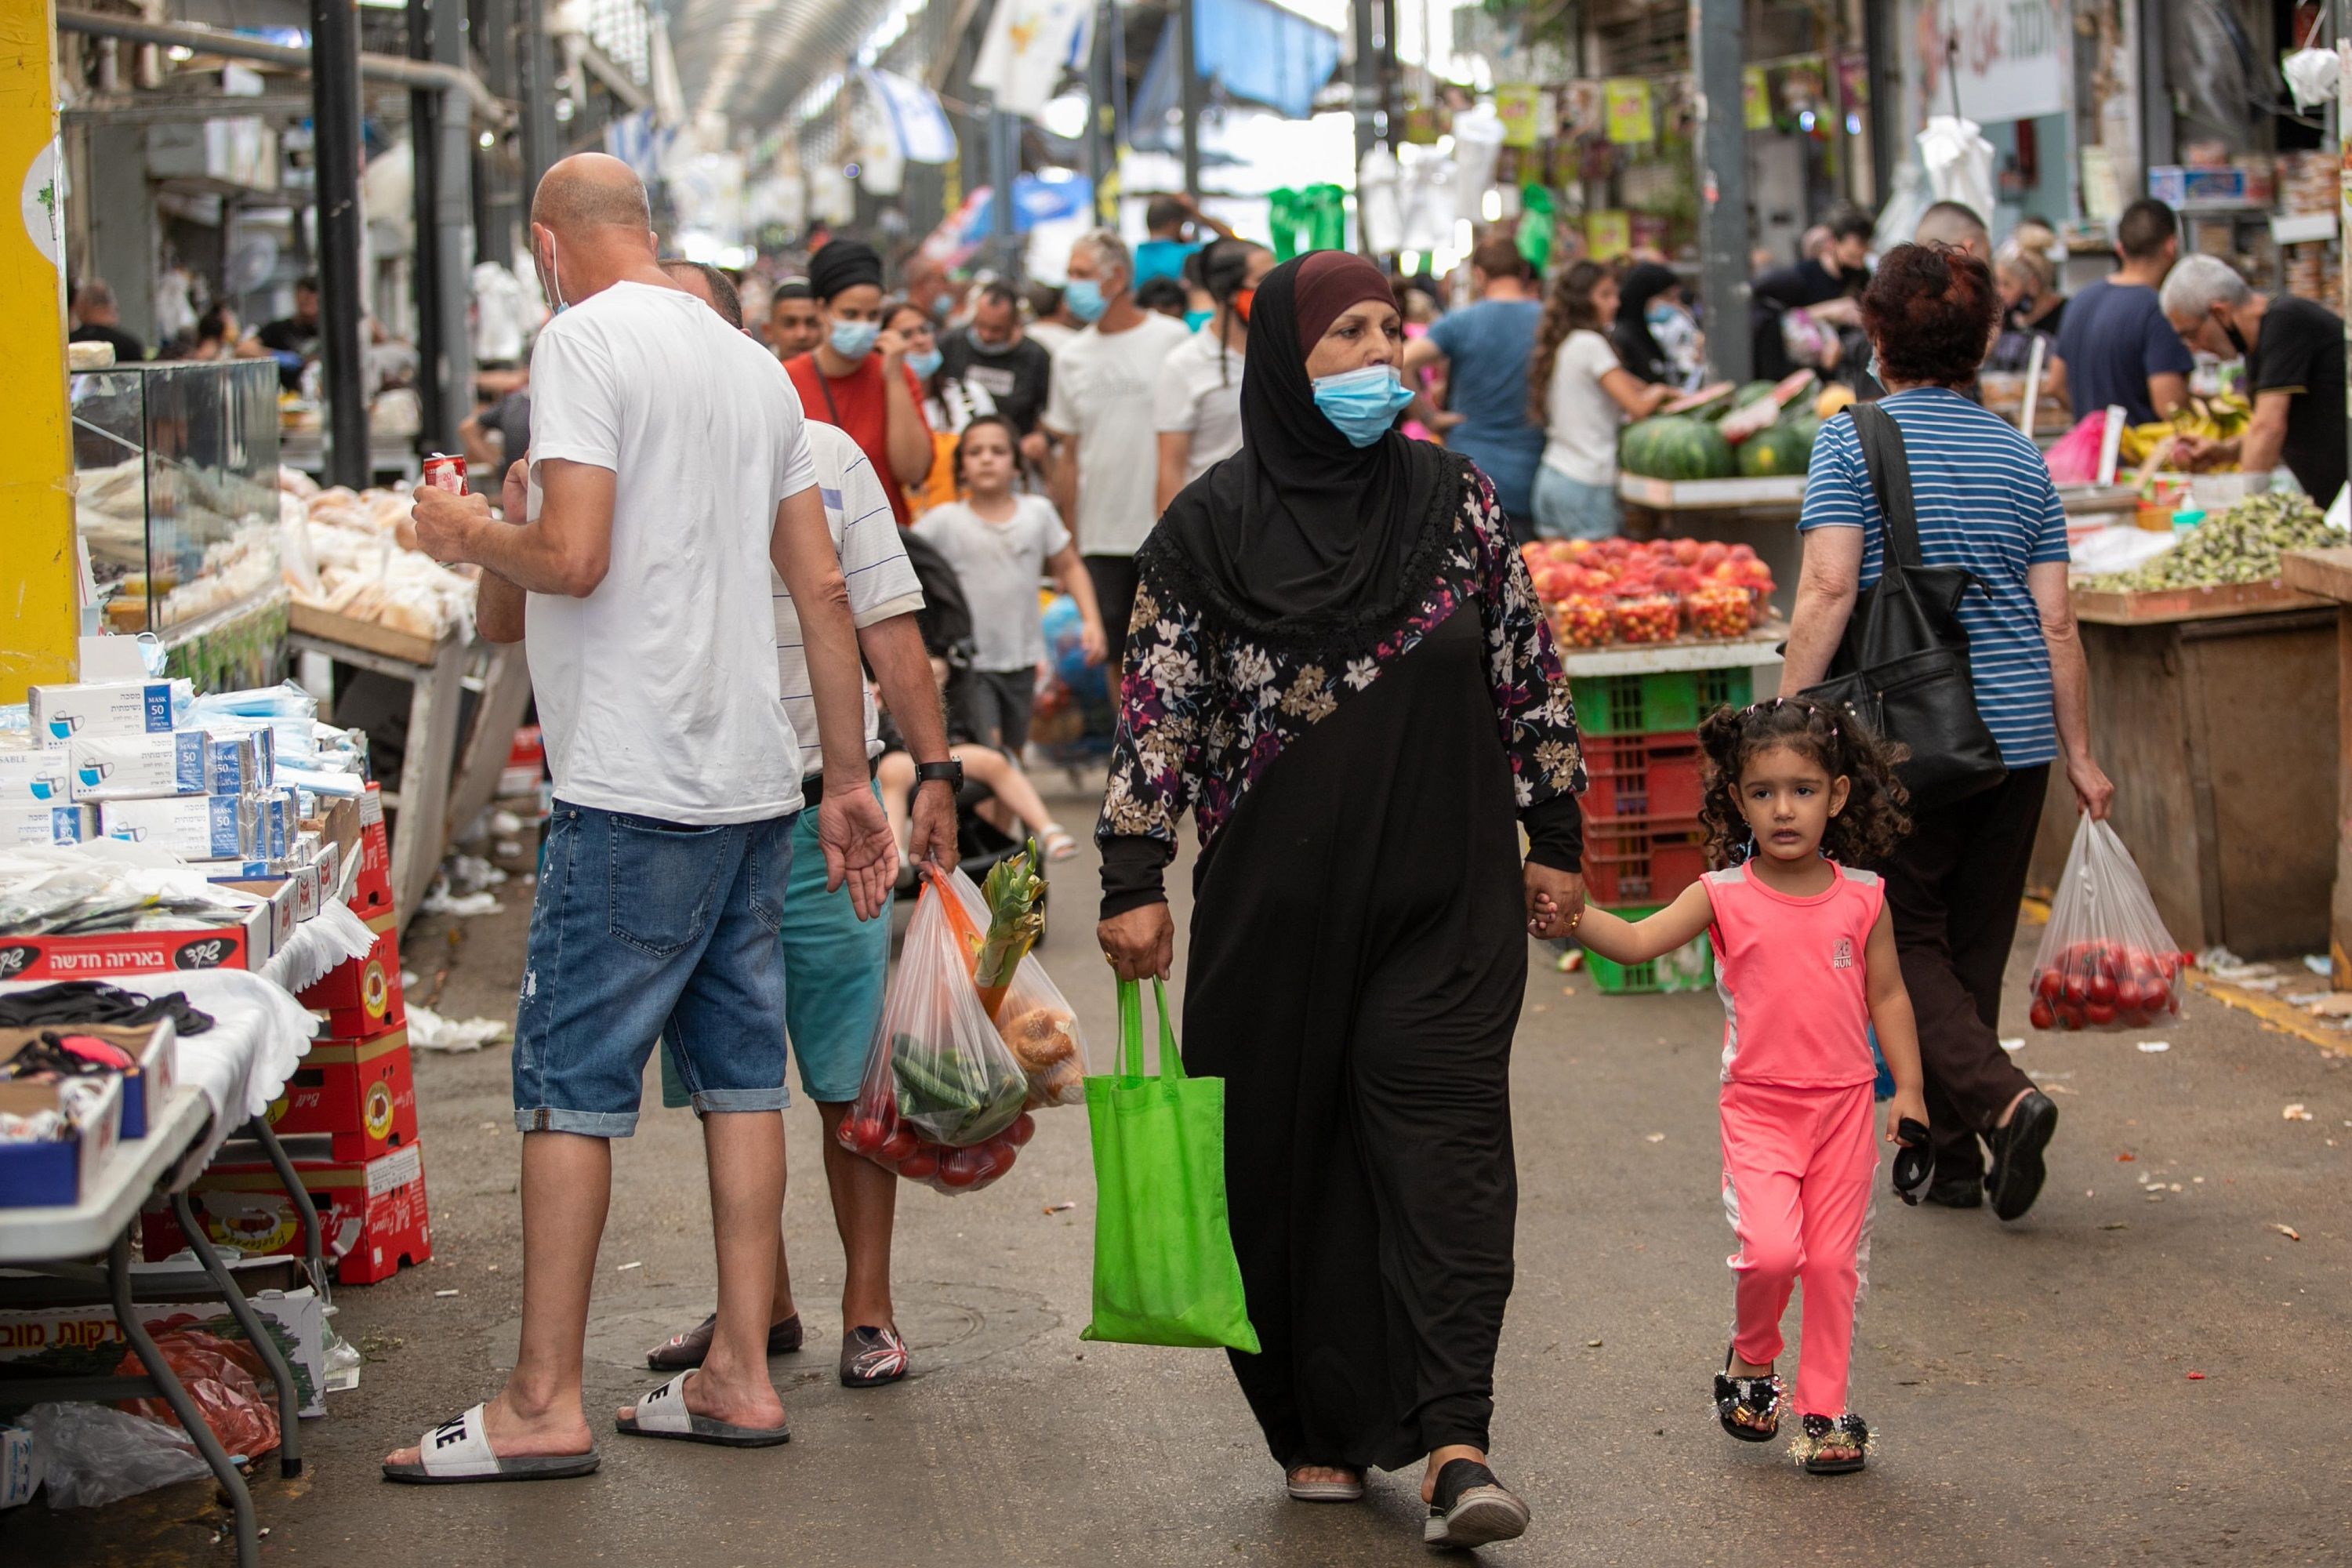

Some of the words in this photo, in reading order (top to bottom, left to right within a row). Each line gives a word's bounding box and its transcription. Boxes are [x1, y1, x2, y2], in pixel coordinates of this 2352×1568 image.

[111, 704, 142, 713] נשימתית
[151, 706, 164, 715] 50
[183, 752, 196, 762] 50
[217, 764, 229, 773] 50
[216, 816, 230, 826] 50
[50, 953, 101, 969] חדשה
[106, 951, 165, 967] באריזה
[1834, 959, 1851, 968] RUN
[295, 1091, 321, 1109] Bell
[394, 1203, 410, 1234] Bell
[56, 1319, 125, 1351] רקות
